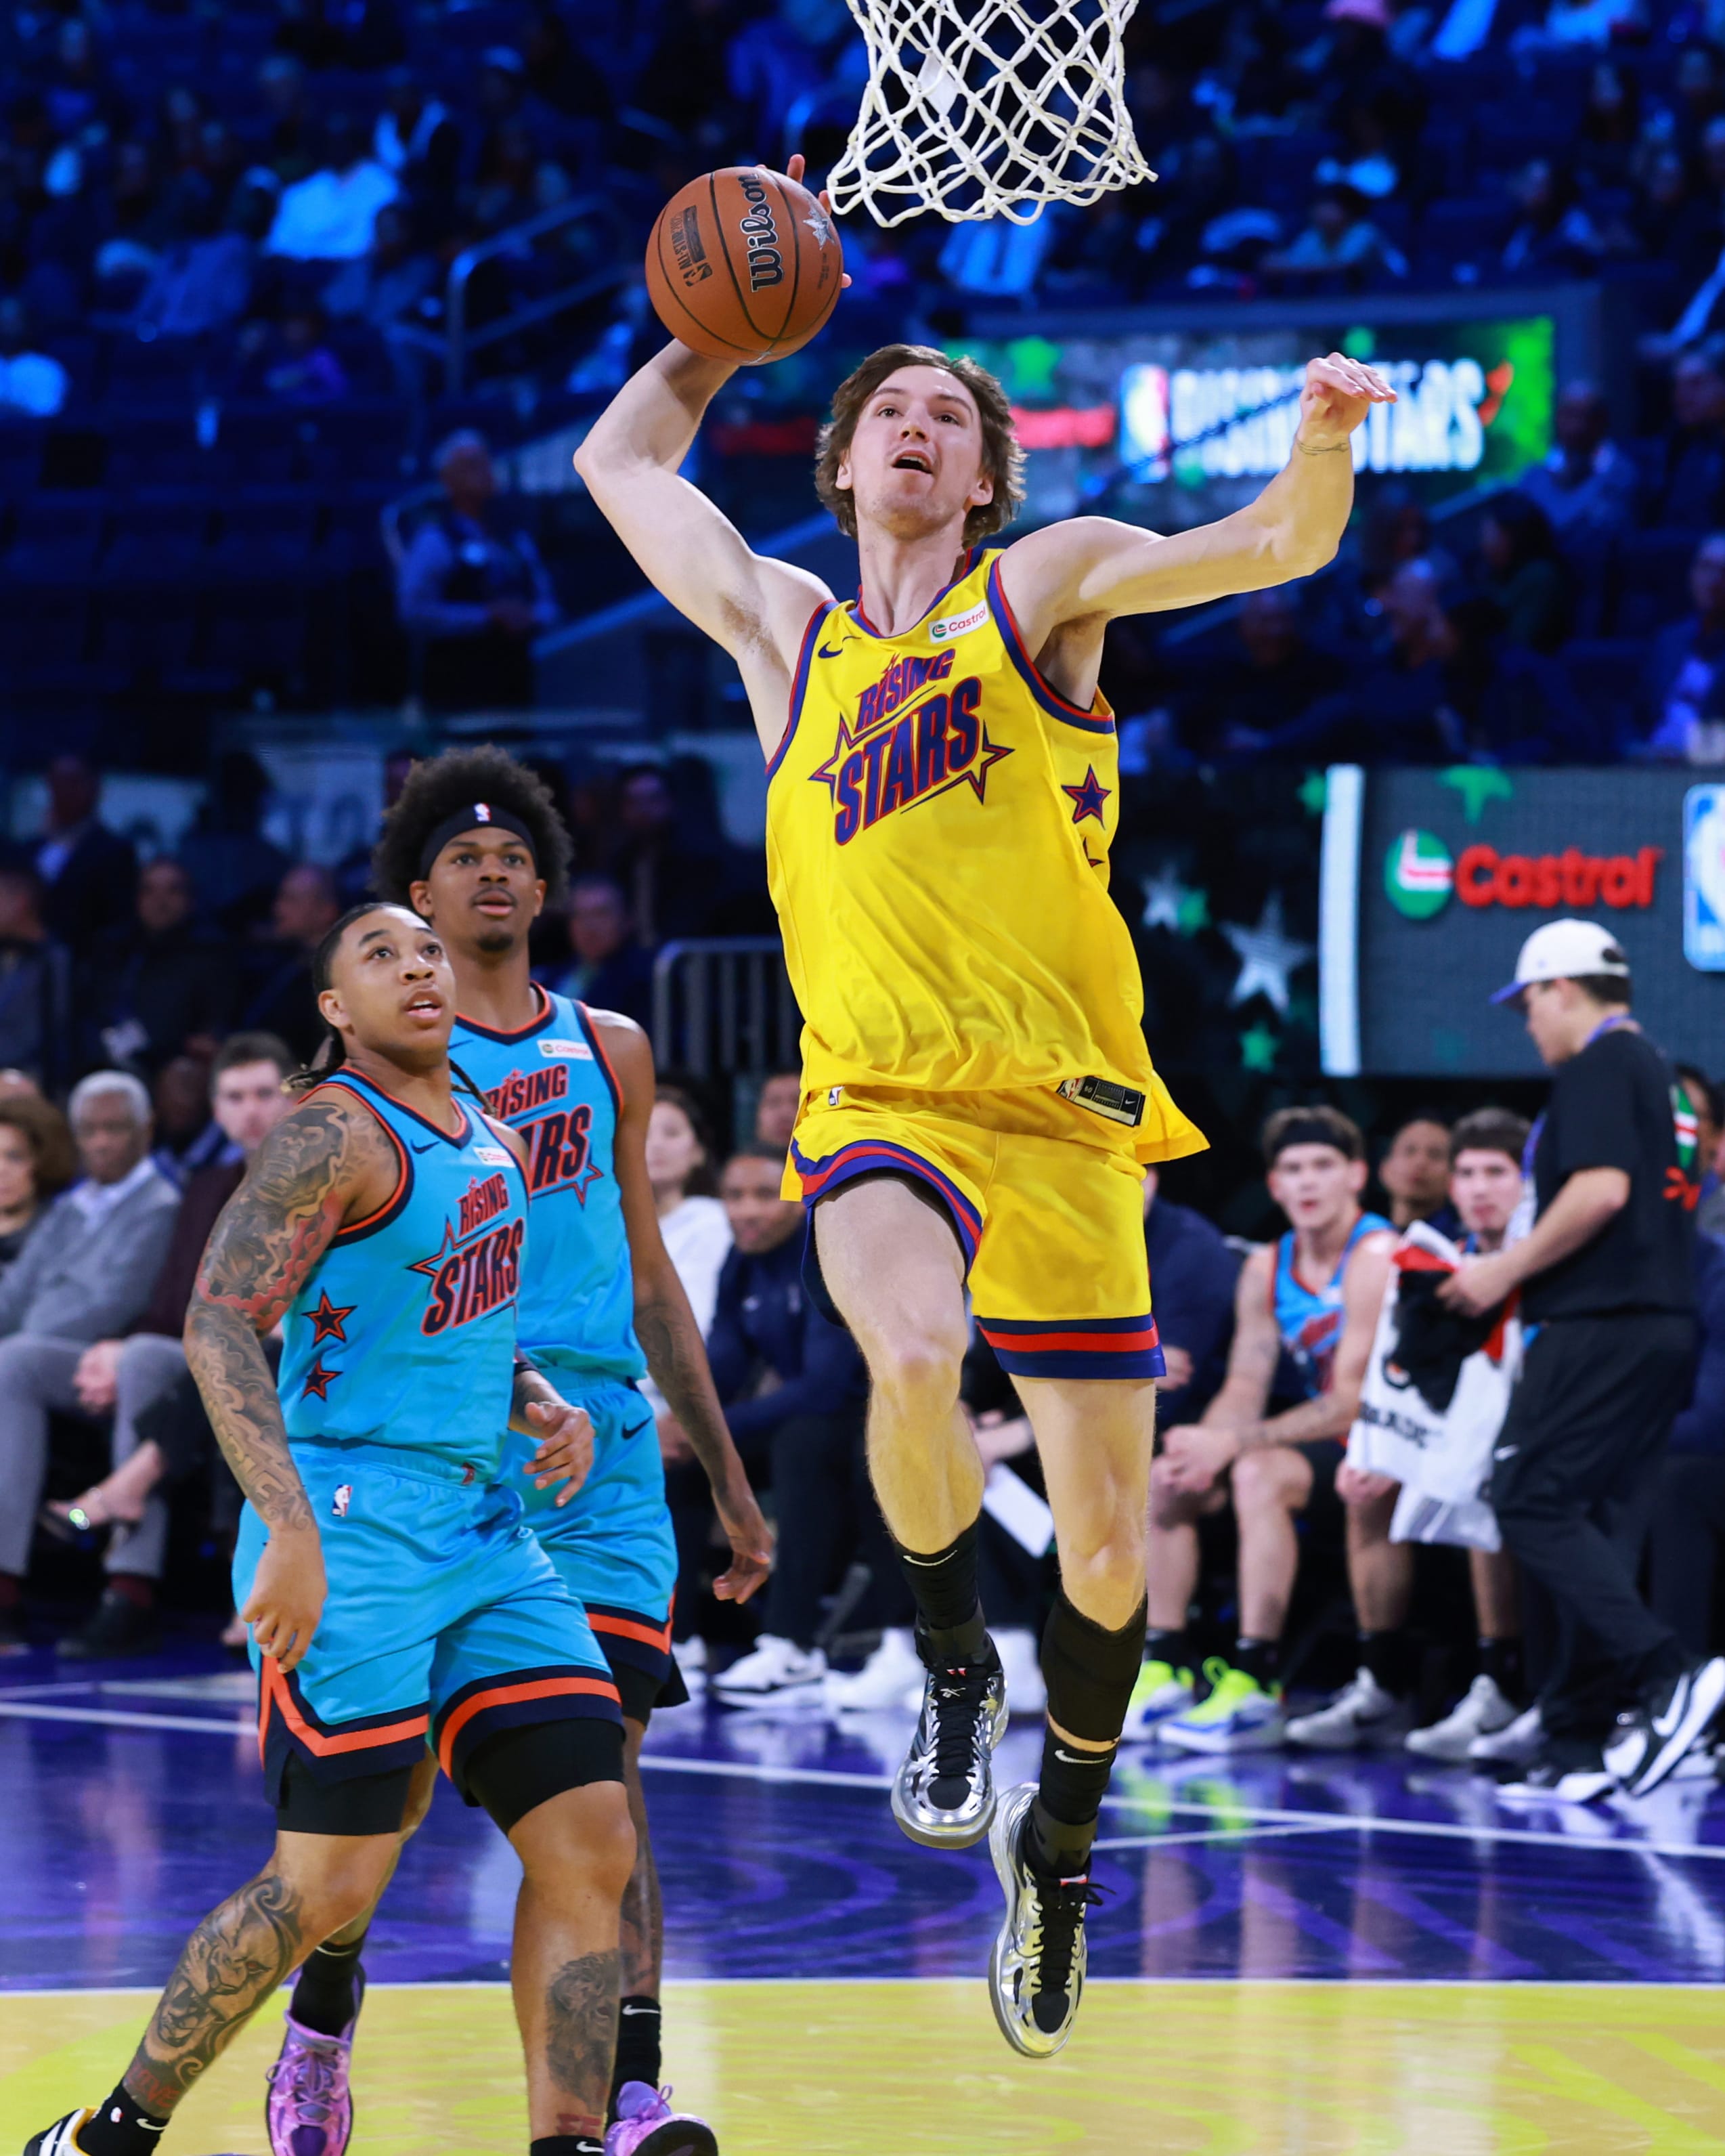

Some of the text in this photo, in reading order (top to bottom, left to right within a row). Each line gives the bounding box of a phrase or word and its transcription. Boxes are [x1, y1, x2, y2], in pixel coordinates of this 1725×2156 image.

[737, 173, 784, 293] Wilson
[948, 606, 986, 632] Castrol
[854, 648, 956, 733] RISING
[834, 676, 982, 846] STARS
[1455, 844, 1662, 908] Castrol
[456, 1172, 509, 1239] RISING
[420, 1217, 523, 1337] STARS
